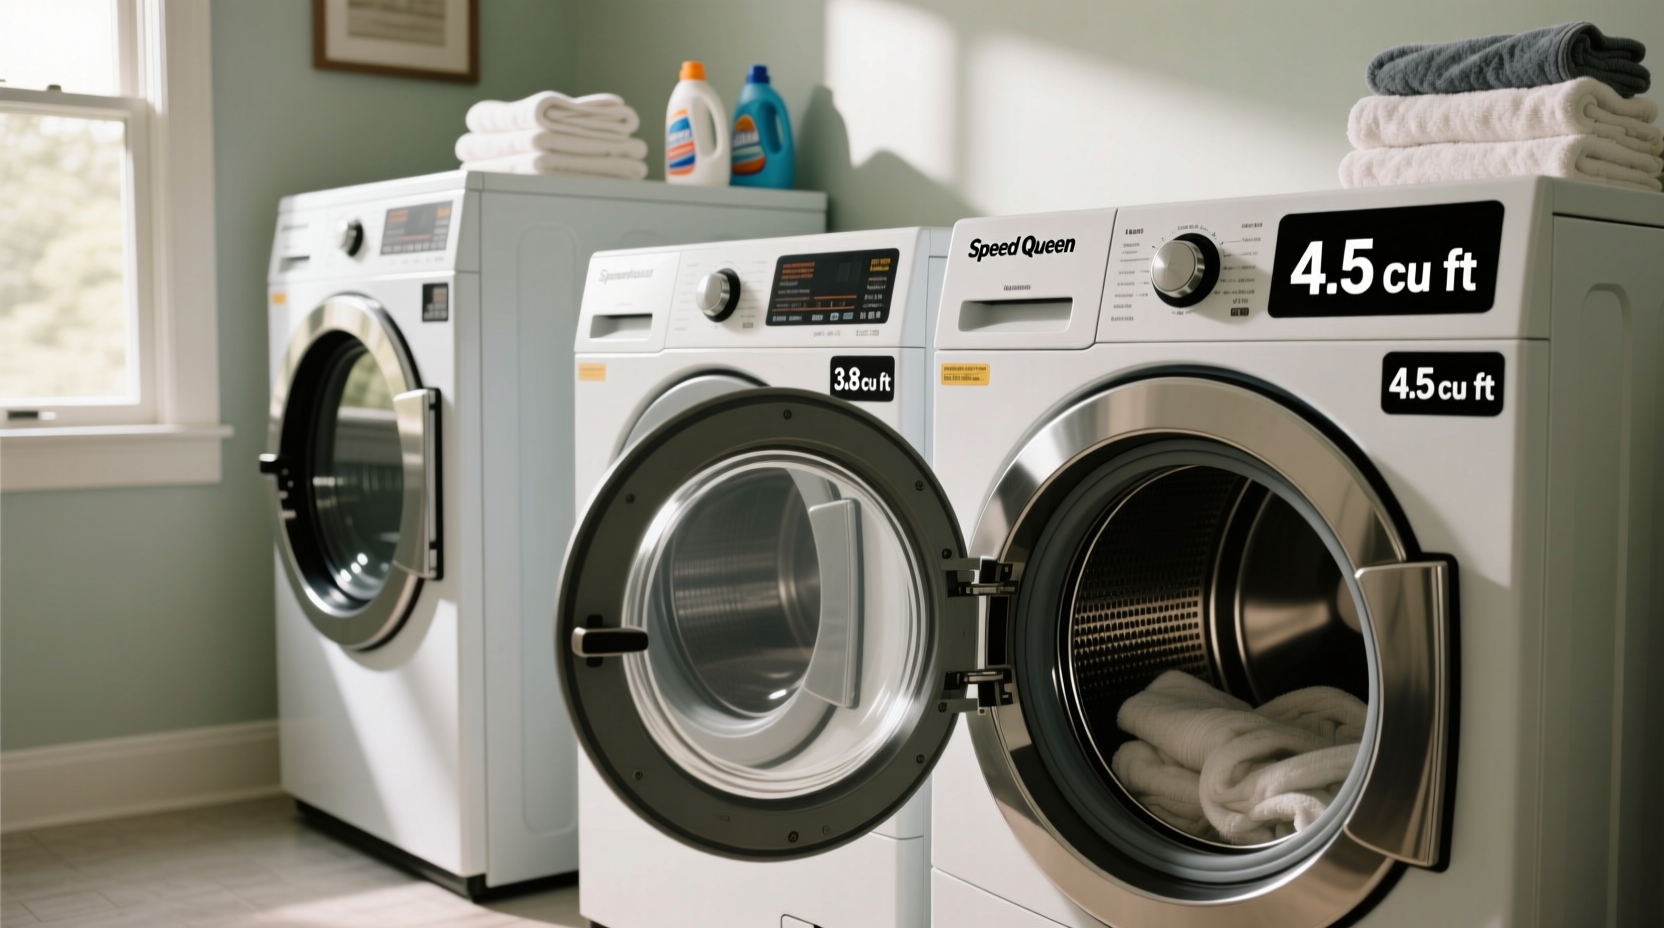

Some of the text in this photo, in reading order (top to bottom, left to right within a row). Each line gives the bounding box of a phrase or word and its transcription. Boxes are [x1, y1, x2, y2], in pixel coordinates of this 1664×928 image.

[968, 235, 1076, 262] Speed Queen
[1290, 238, 1477, 295] 4.5 cu ft
[834, 367, 891, 391] 3.8 cu ft
[1389, 367, 1495, 401] 4.5 cu ft
